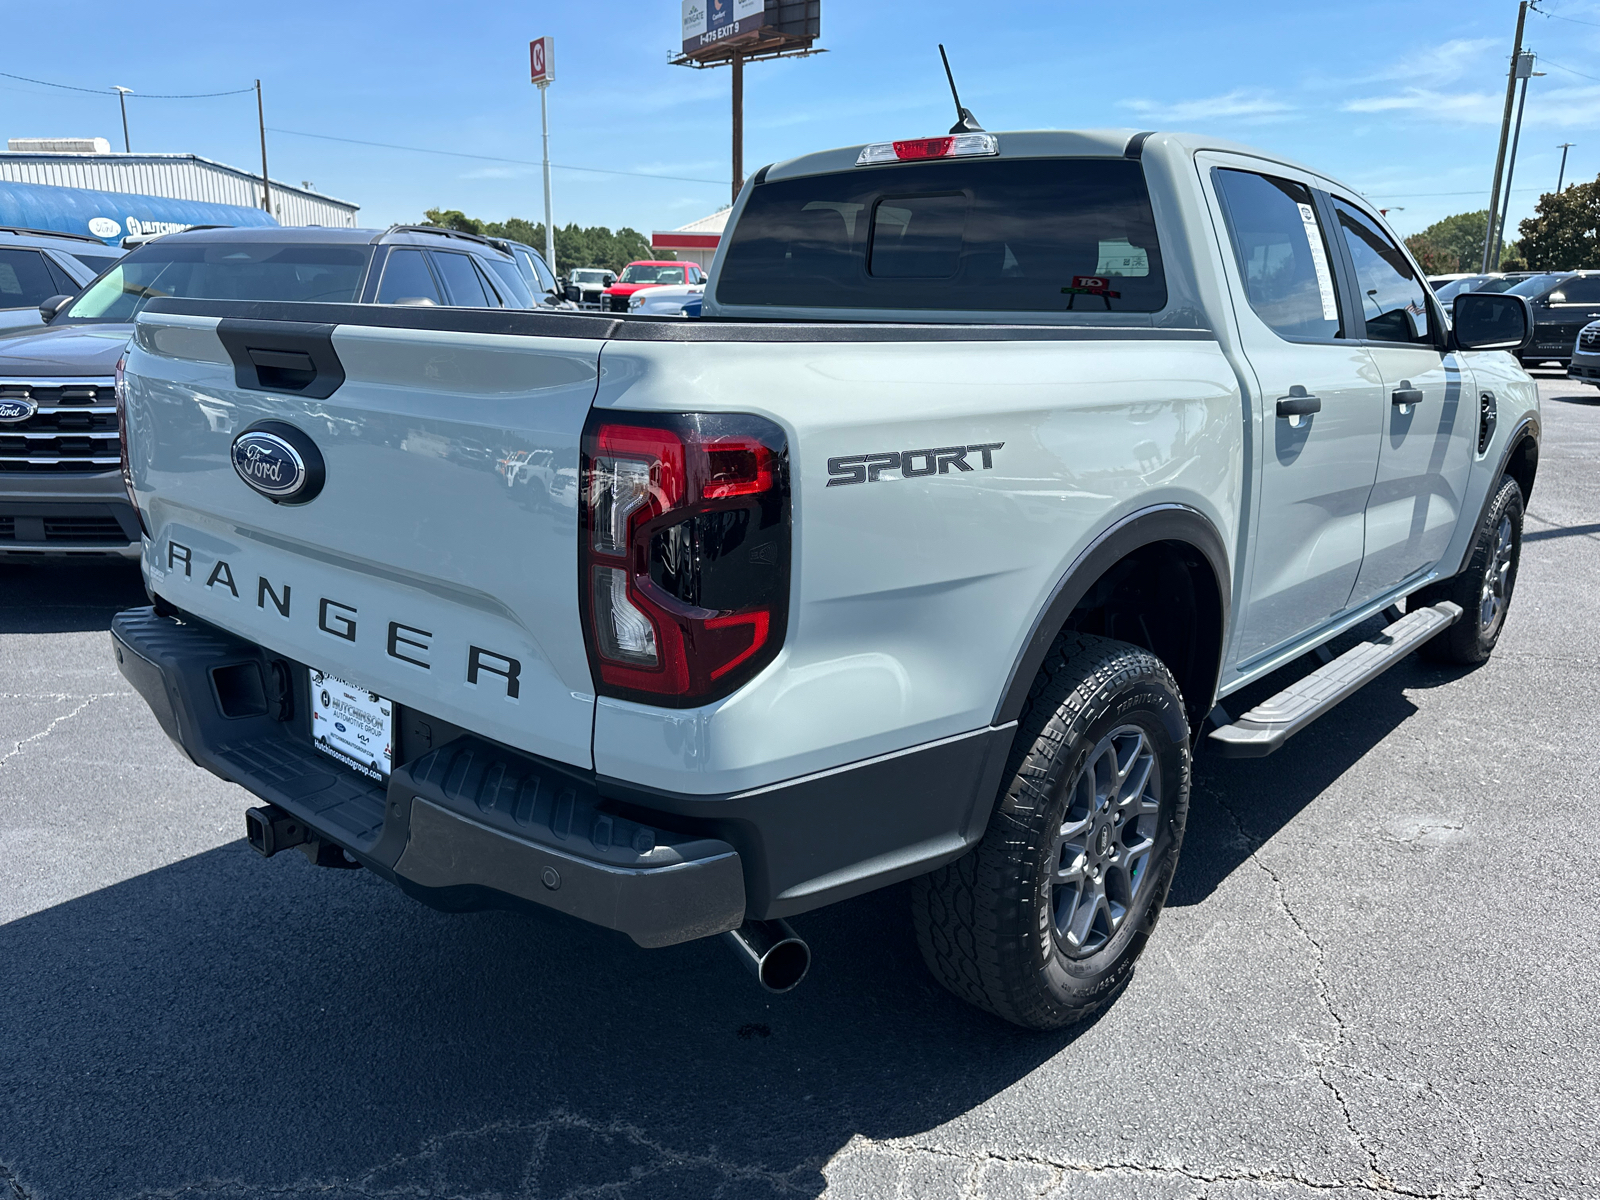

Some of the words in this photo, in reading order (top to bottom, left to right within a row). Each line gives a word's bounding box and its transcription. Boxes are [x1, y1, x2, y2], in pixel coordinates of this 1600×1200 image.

[700, 30, 717, 45] I-475
[717, 23, 734, 39] EXIT
[734, 22, 740, 33] 9
[244, 444, 283, 482] Ford
[826, 442, 1005, 487] SPORT
[168, 541, 522, 700] RANGER
[332, 697, 384, 731] HUTCHINSON
[333, 711, 364, 730] AUTOMOTIVE
[365, 725, 382, 738] GROUP
[314, 739, 382, 781] Hutchinsonautogroup.com
